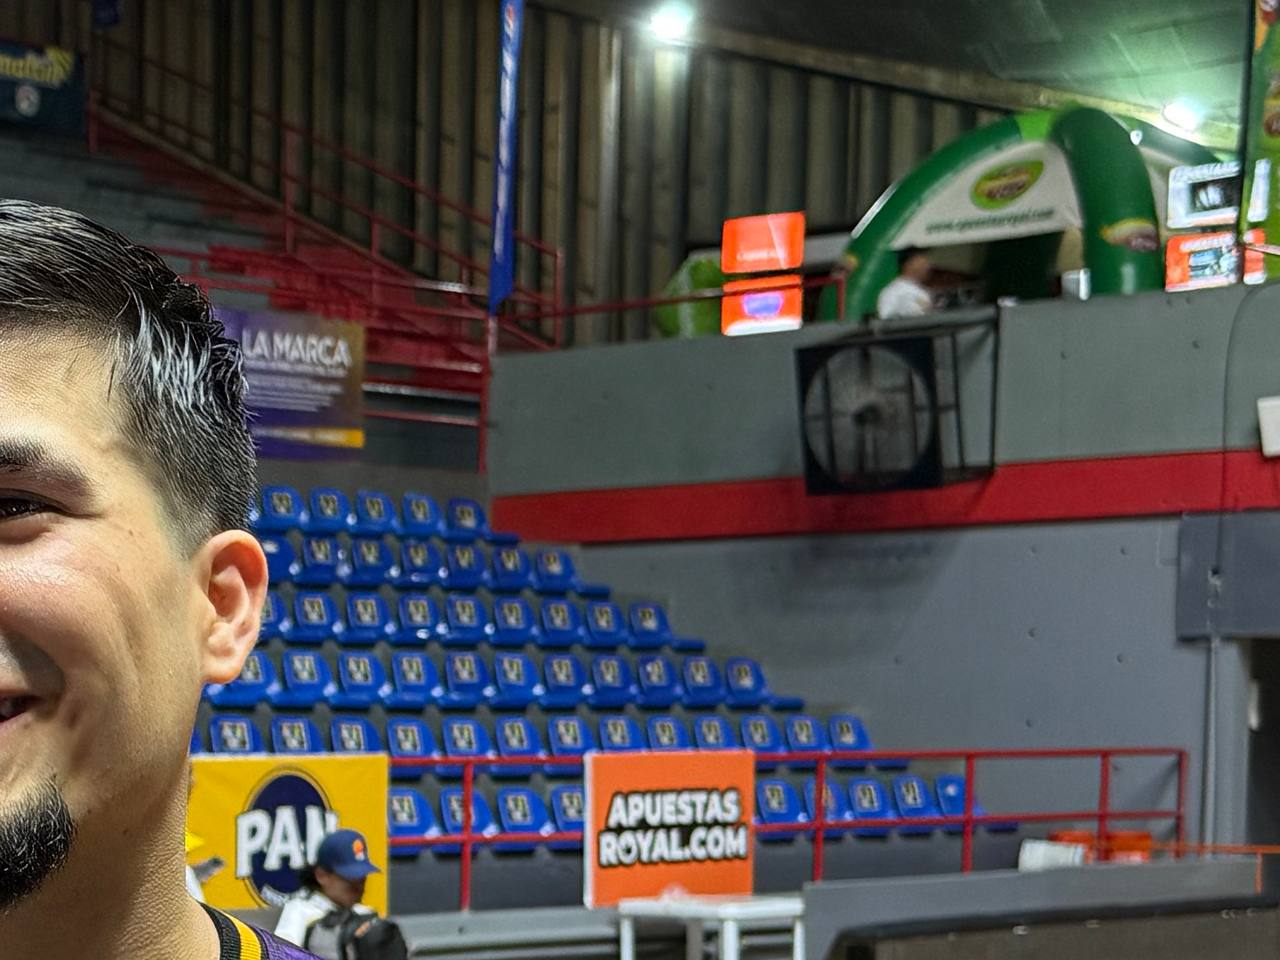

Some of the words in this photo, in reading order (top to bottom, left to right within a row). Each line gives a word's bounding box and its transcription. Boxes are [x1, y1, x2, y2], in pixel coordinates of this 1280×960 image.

[241, 329, 270, 359] LA
[272, 331, 353, 368] MARCA
[607, 788, 741, 829] APUESTAS
[598, 824, 748, 867] ROYAL.COM
